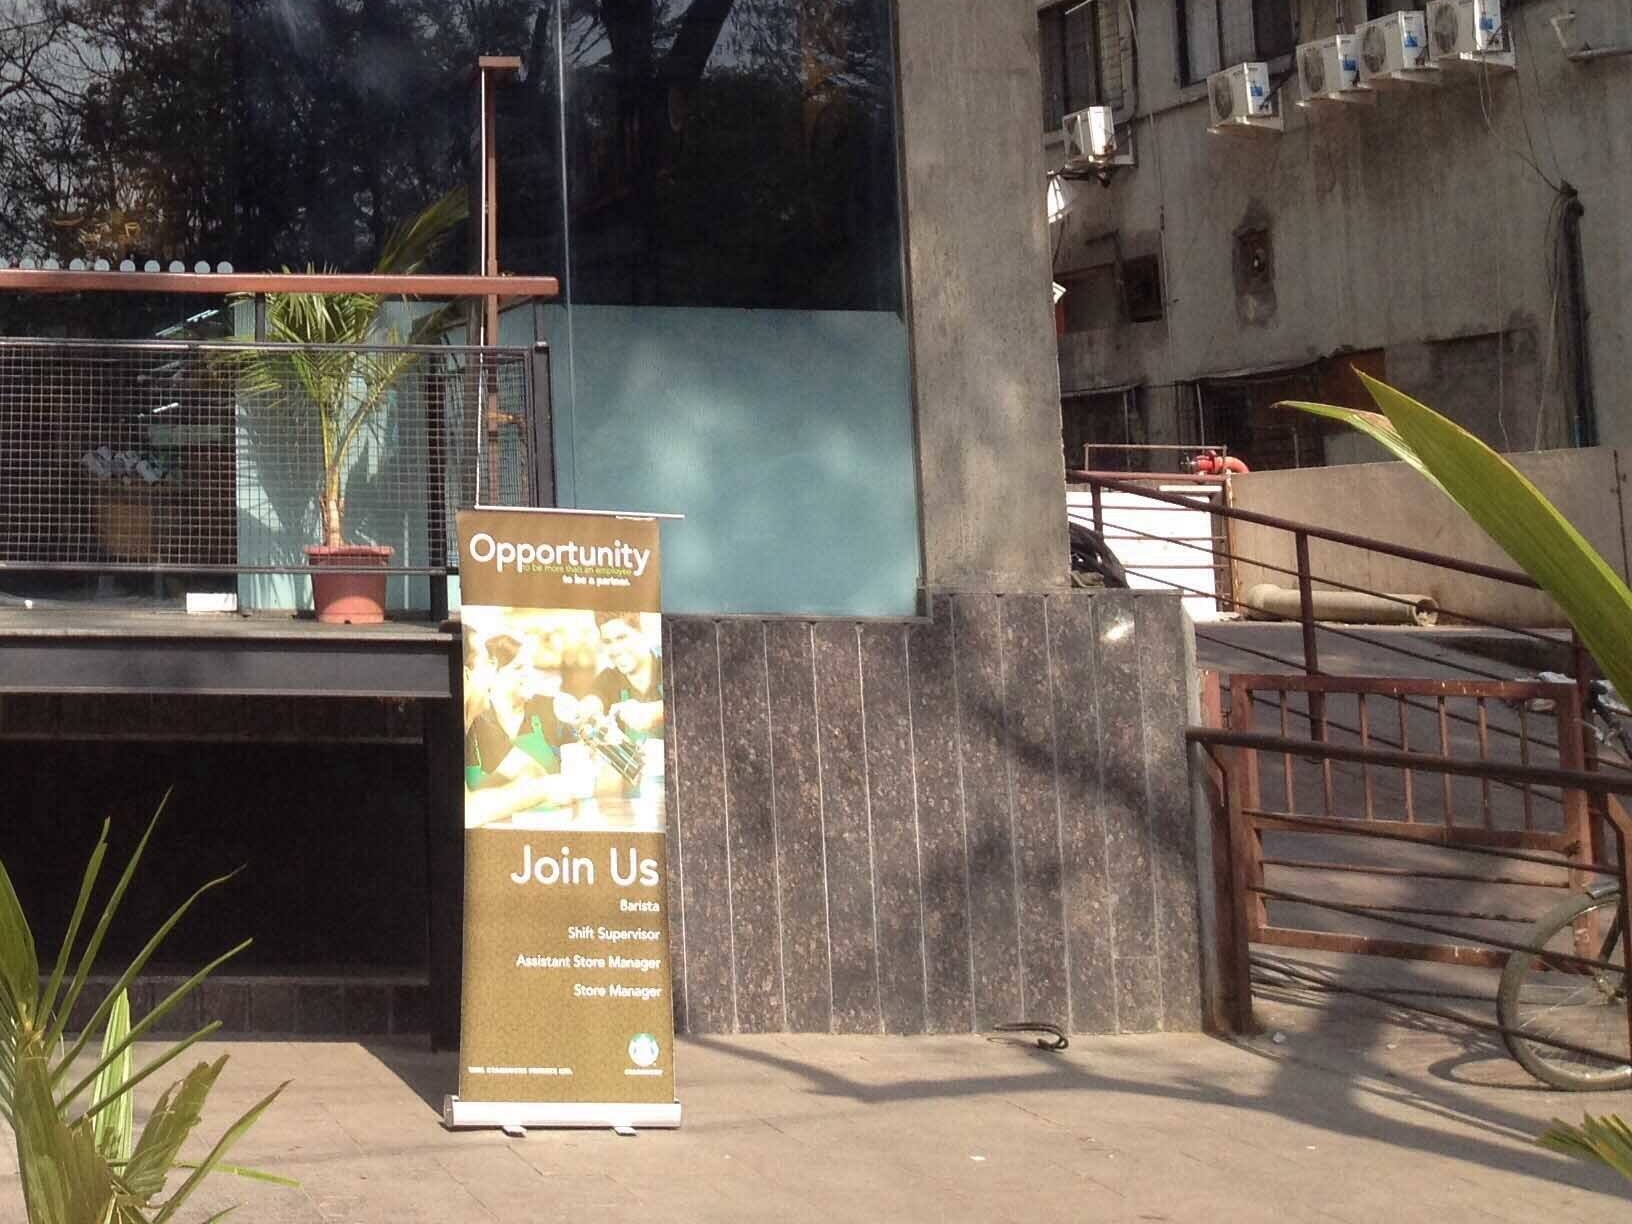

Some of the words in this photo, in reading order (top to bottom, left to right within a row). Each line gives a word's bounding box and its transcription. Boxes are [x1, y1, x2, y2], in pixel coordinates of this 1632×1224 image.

[469, 533, 651, 576] Opportunity
[510, 844, 594, 885] Join
[610, 847, 660, 887] Us
[620, 899, 660, 913] Barista
[568, 926, 594, 940] Shift
[598, 927, 660, 943] Supervisor
[516, 954, 570, 968] Assistant
[573, 955, 605, 968] Store
[608, 956, 661, 971] Manager
[573, 983, 606, 997] Store
[609, 984, 662, 1000] Manager
